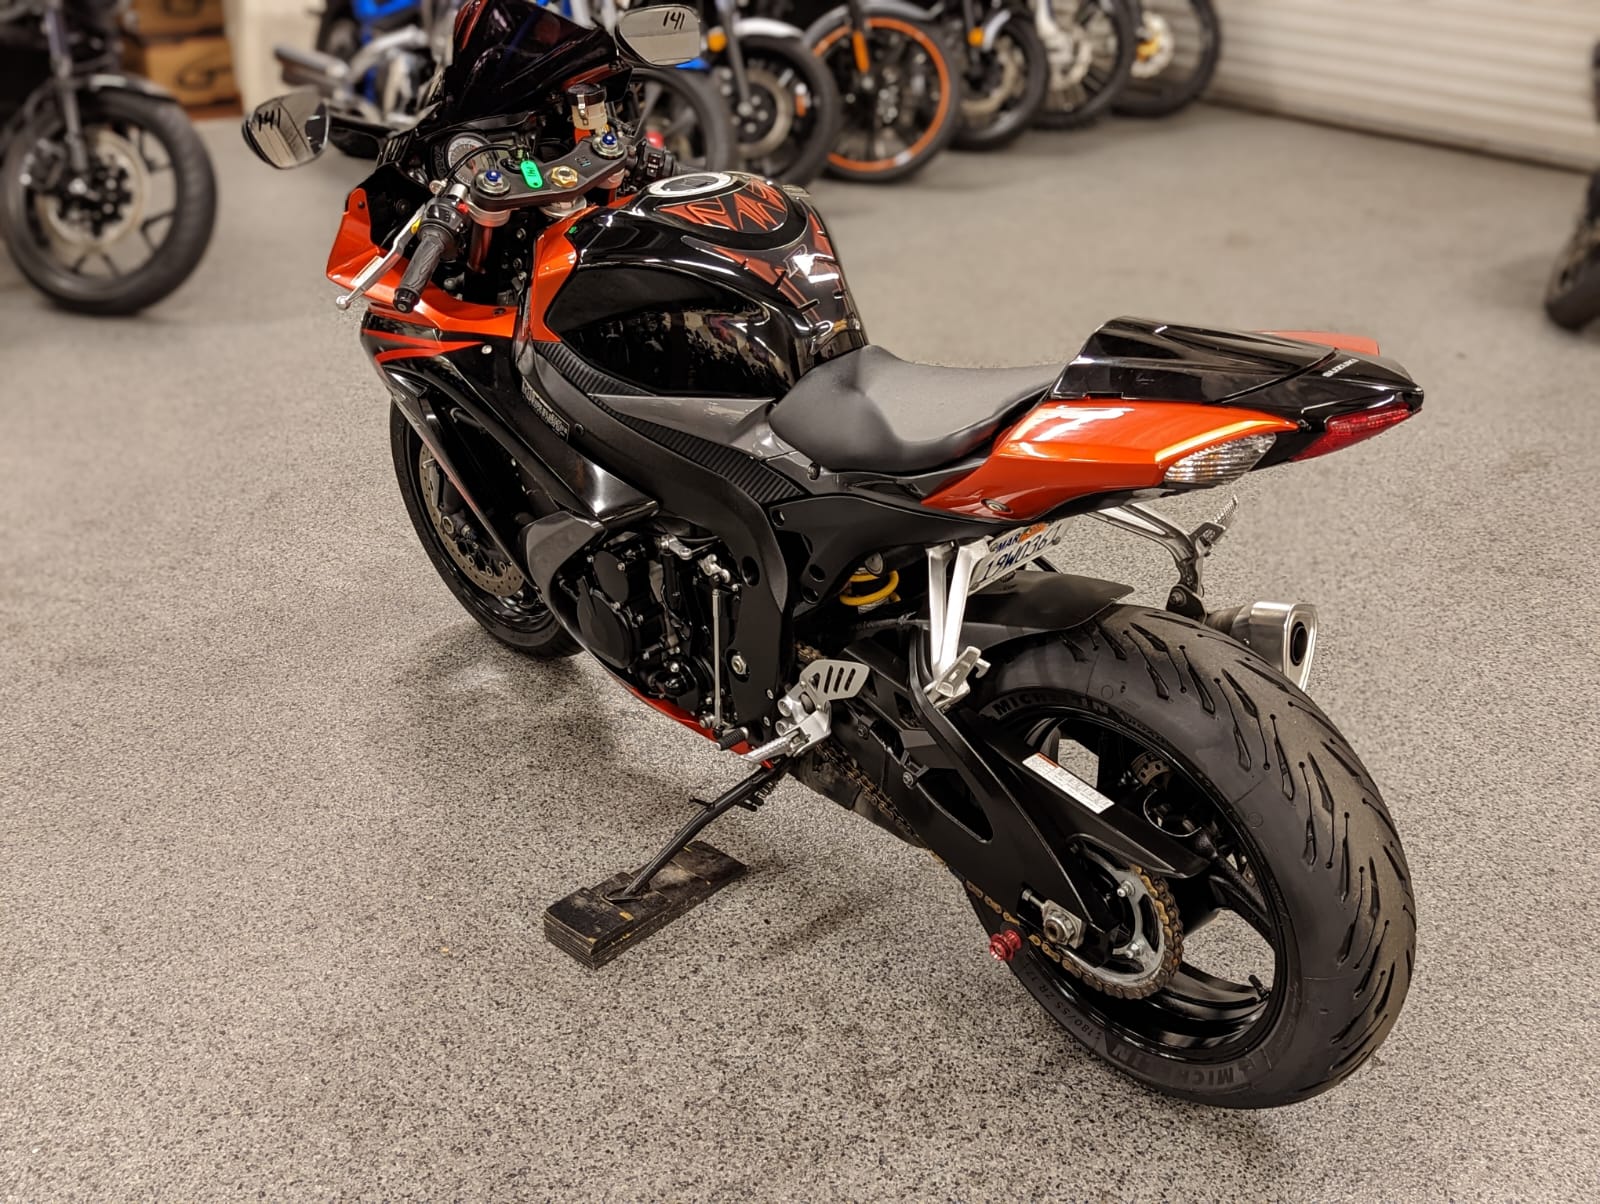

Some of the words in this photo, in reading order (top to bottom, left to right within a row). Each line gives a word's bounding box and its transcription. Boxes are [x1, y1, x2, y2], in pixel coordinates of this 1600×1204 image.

[662, 11, 685, 30] 141
[258, 107, 281, 132] 141
[1322, 358, 1360, 378] SUZUKI
[992, 692, 1109, 716] MICHIN
[1109, 1044, 1235, 1086] MICHIN
